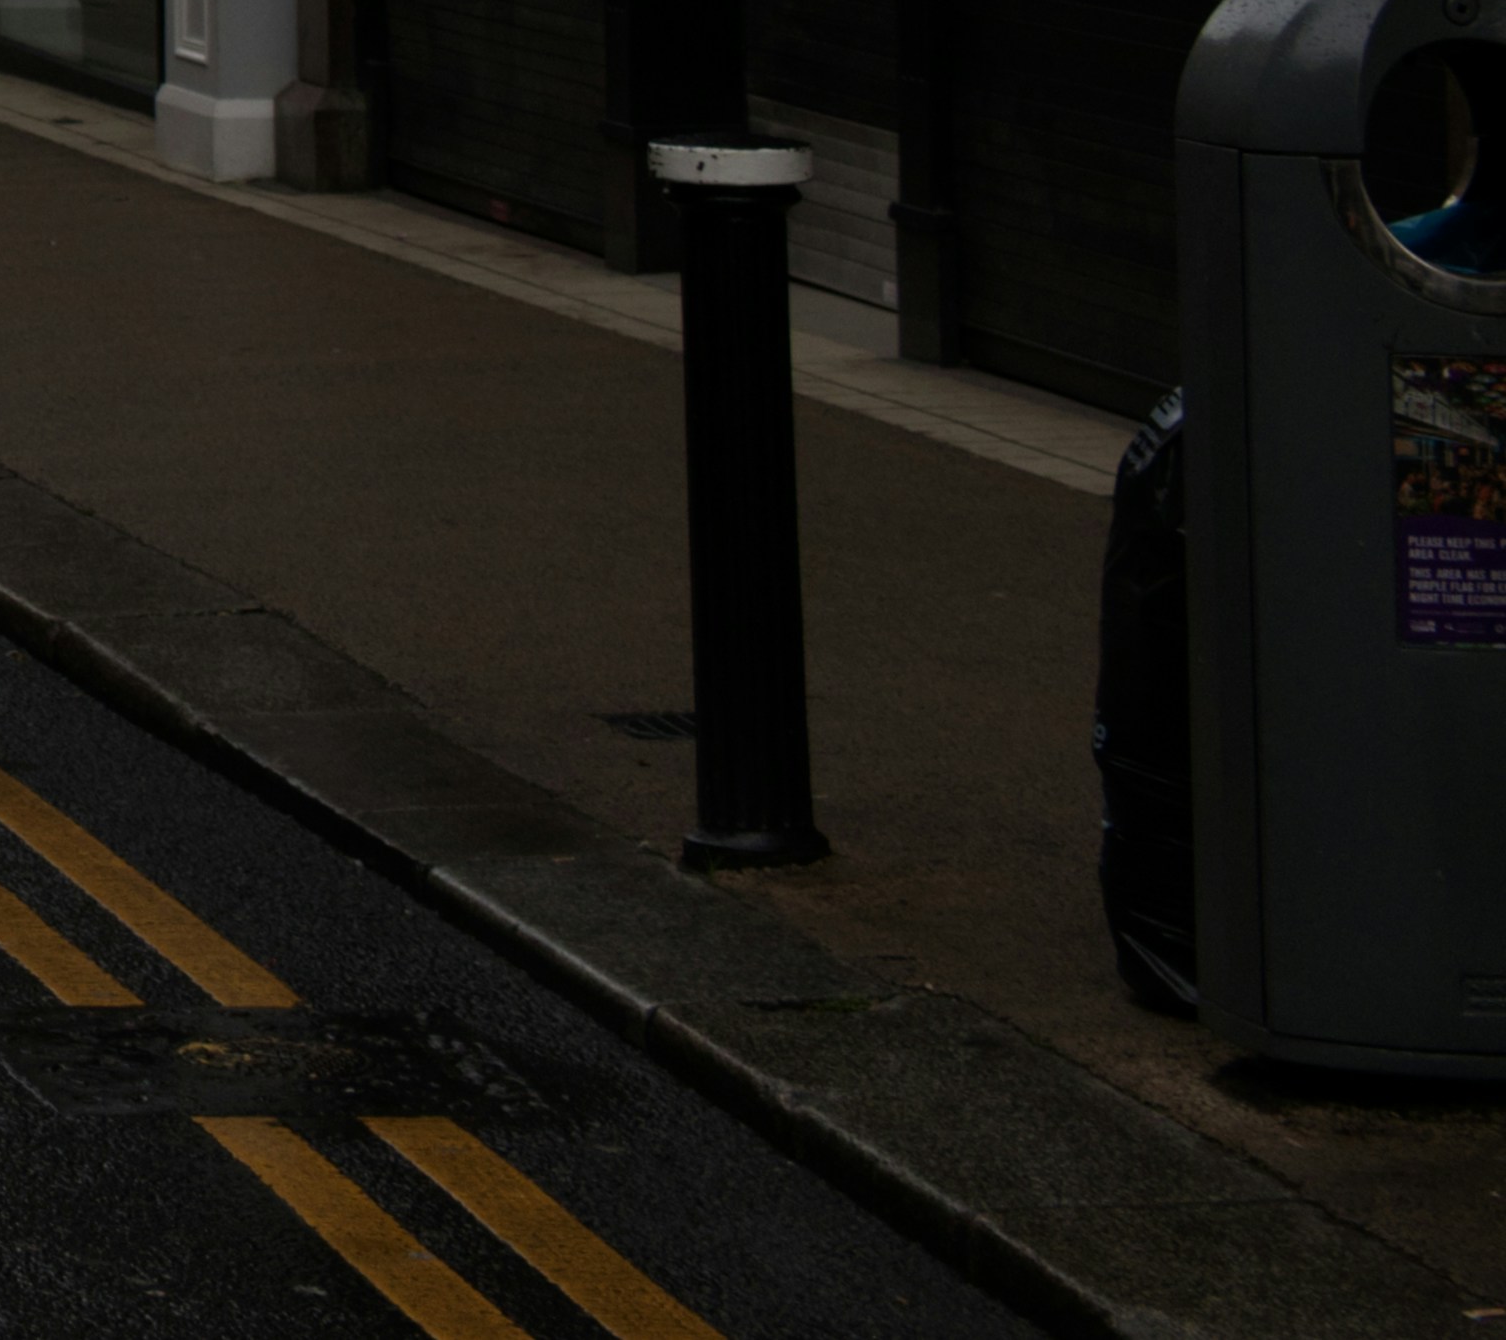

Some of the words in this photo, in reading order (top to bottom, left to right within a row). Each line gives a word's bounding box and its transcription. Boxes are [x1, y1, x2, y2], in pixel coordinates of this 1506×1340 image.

[1407, 535, 1444, 548] PLEASE
[1446, 536, 1472, 549] KEEP
[1474, 537, 1496, 549] THIS
[1408, 548, 1435, 560] AREA
[1408, 567, 1432, 579] THIS
[1435, 568, 1463, 580] AREA
[1466, 569, 1487, 581] HAS
[1408, 579, 1447, 592] PURPLE
[1449, 580, 1475, 593] FLAG
[1475, 581, 1496, 594] FOR
[1408, 591, 1441, 604] NIGHT
[1442, 592, 1466, 605] TIME
